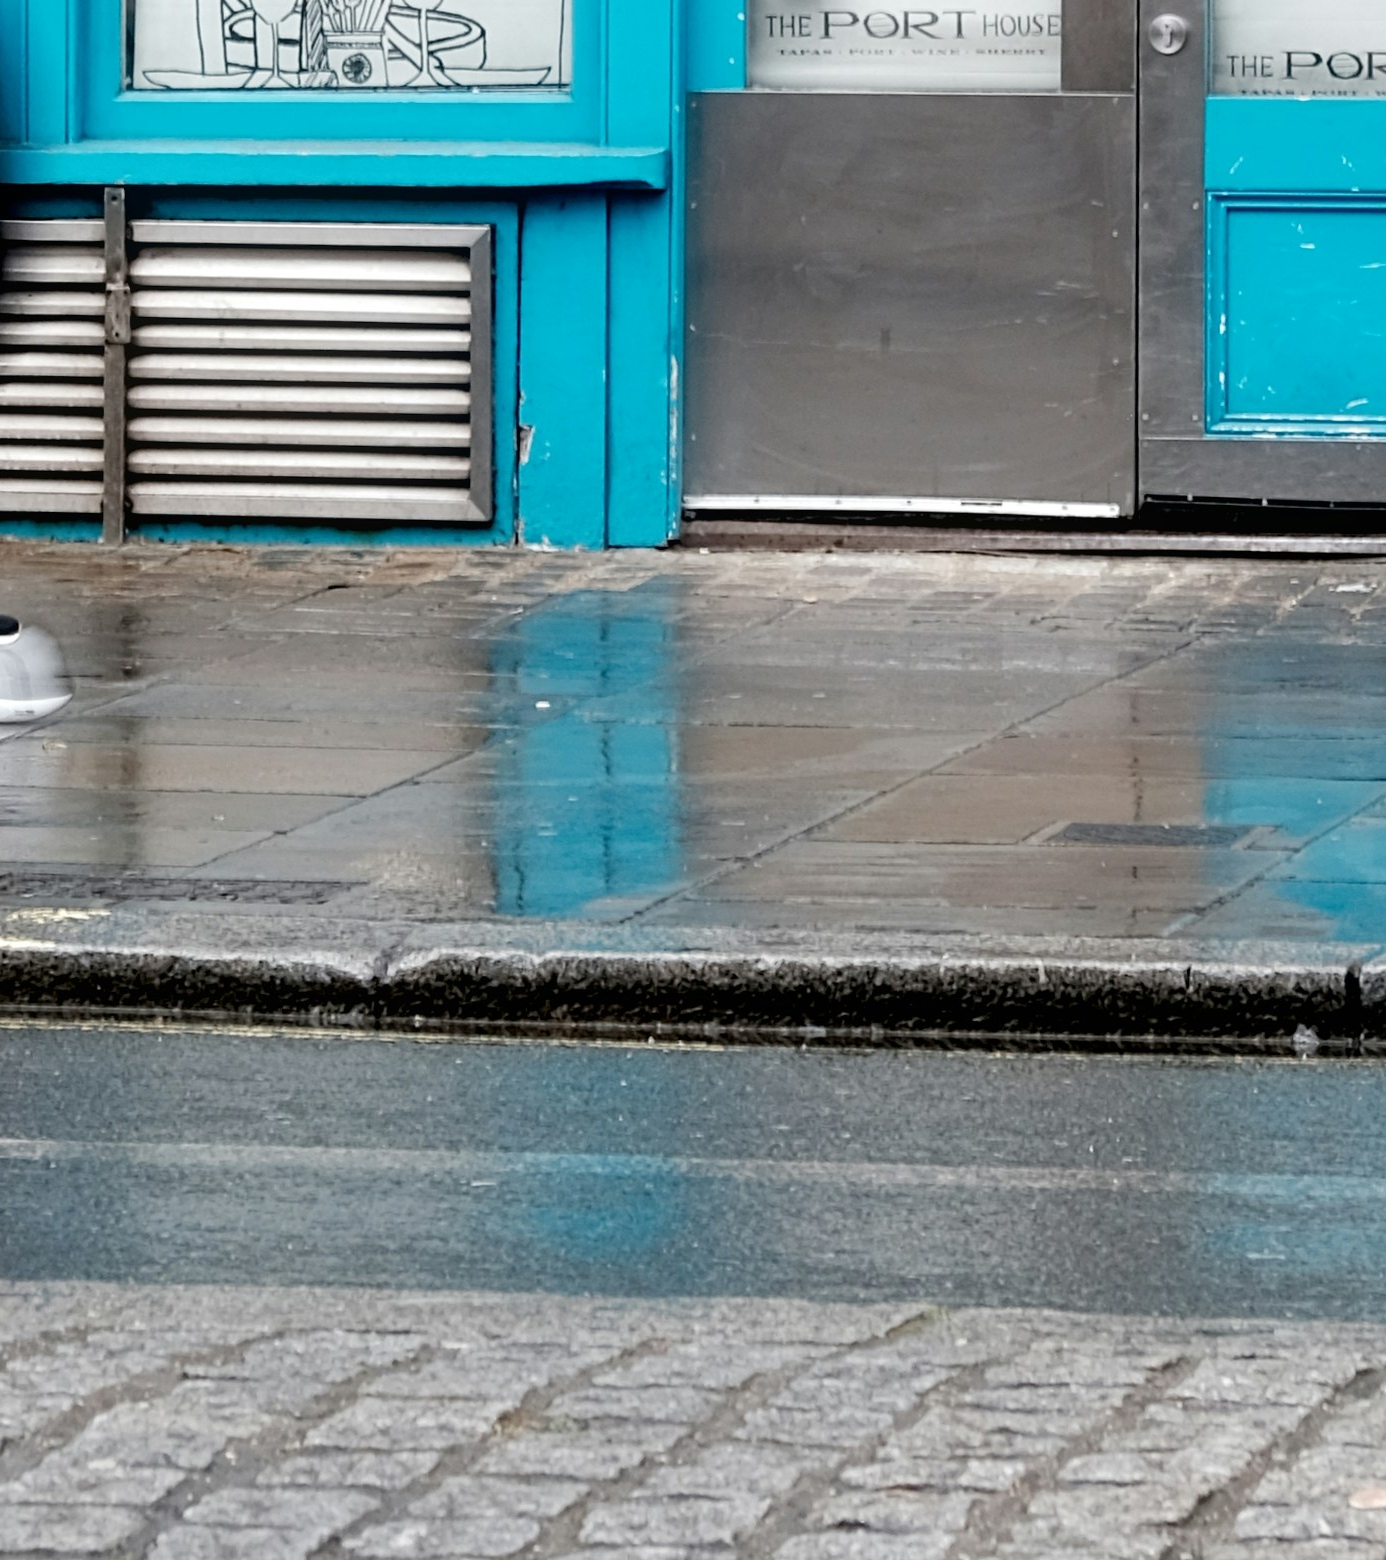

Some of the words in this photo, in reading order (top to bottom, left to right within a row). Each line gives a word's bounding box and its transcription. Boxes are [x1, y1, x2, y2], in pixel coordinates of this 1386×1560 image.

[765, 15, 812, 38] THE
[818, 11, 977, 40] PORT
[982, 14, 1061, 38] HOUSE
[1226, 55, 1274, 79] THE
